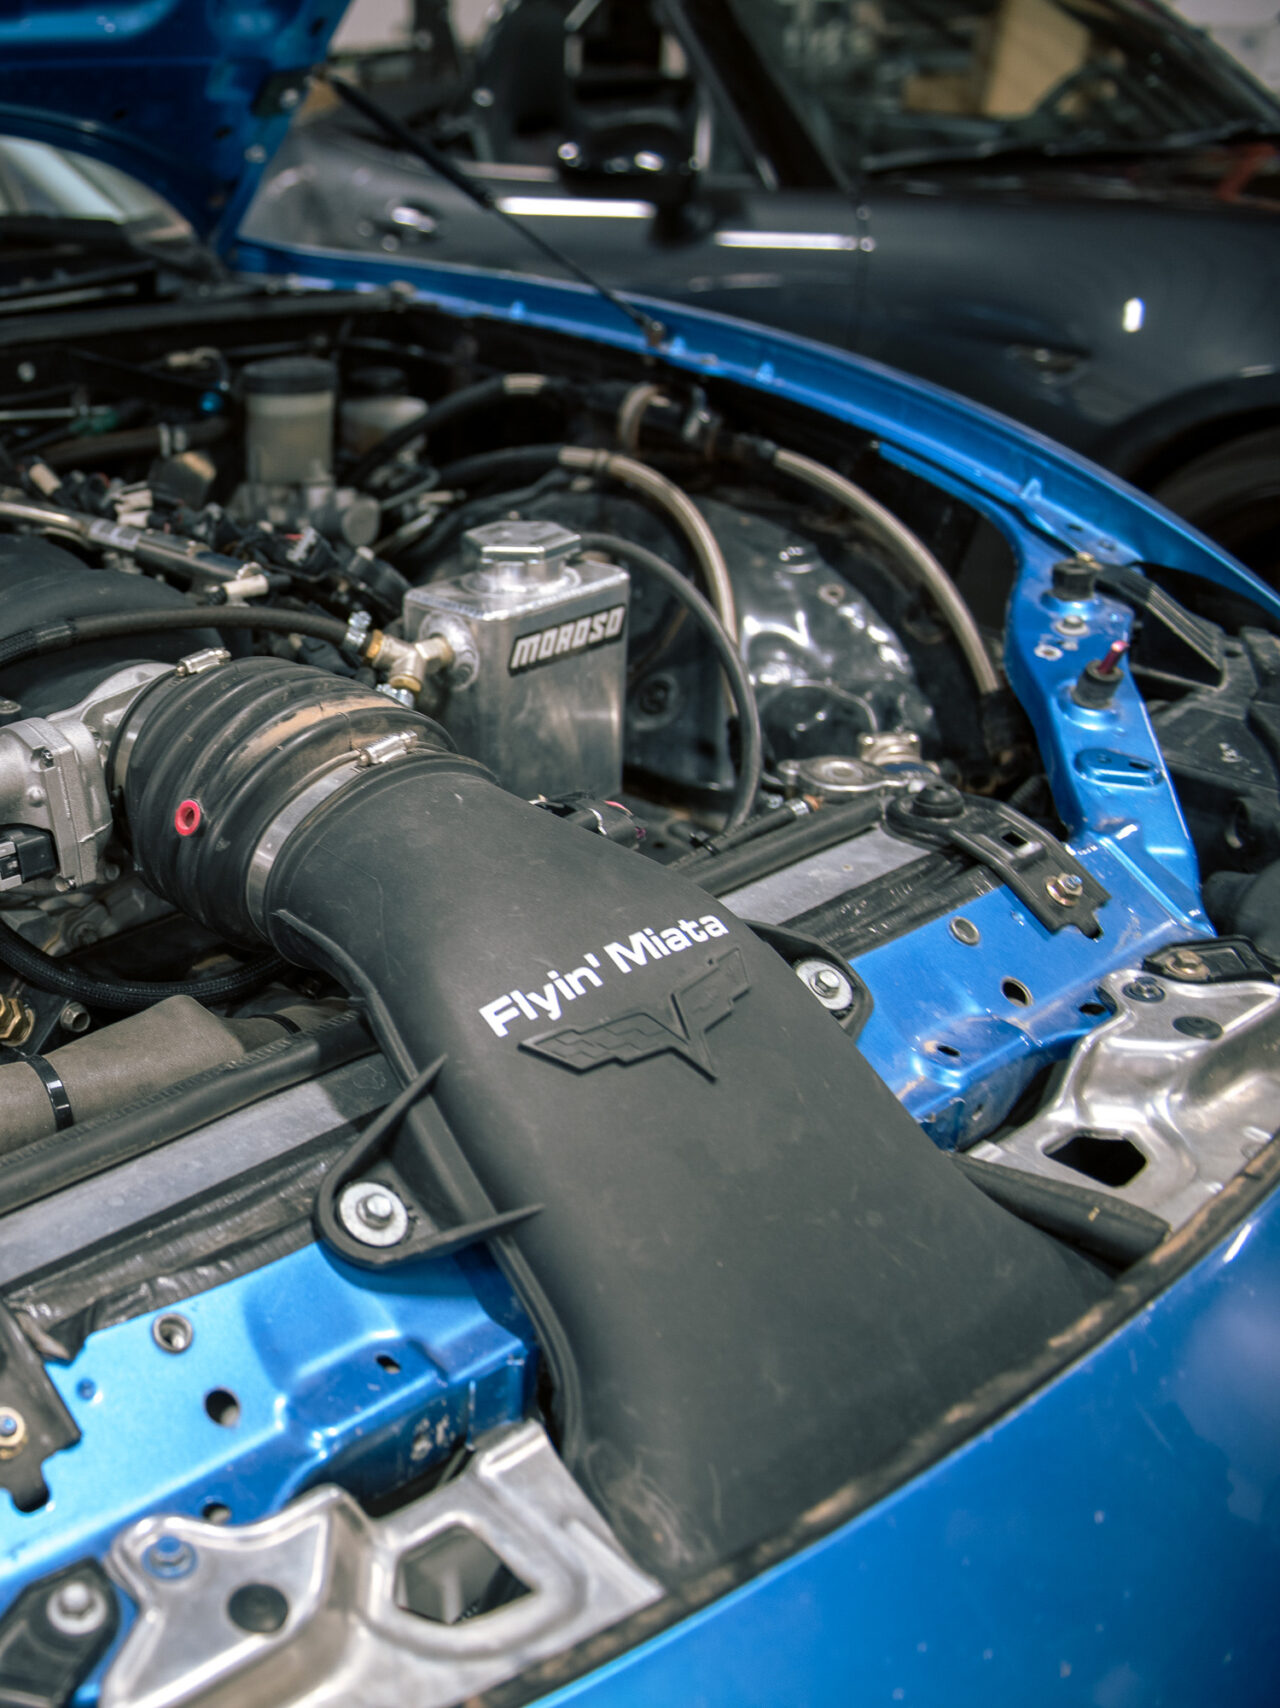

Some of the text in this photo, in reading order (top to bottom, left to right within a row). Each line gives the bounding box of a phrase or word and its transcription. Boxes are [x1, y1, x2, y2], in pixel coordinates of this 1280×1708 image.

[510, 605, 625, 669] MOROSO
[478, 914, 730, 1038] Flyin' Miata
